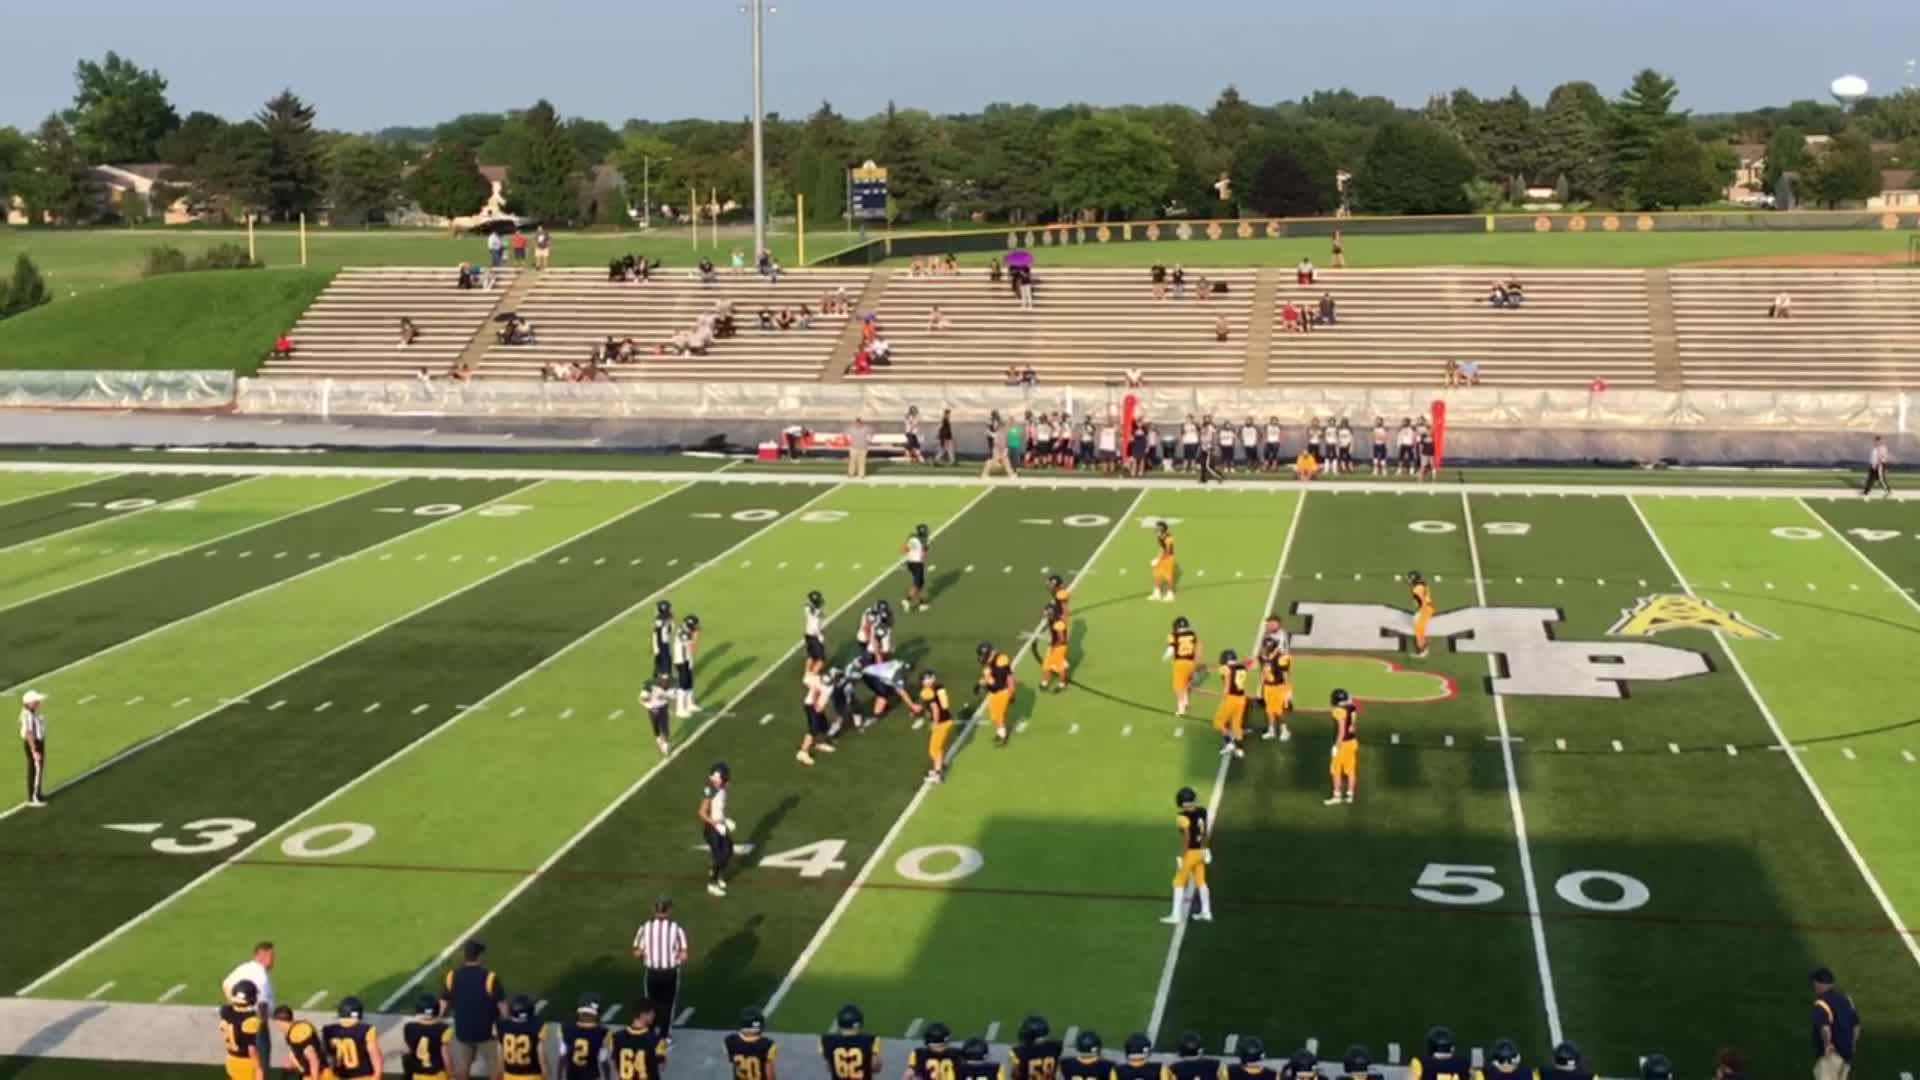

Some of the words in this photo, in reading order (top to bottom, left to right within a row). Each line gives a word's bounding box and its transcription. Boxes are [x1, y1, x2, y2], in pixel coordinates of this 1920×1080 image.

[416, 1036, 431, 1067] 4
[502, 1033, 531, 1065] 82
[572, 1038, 589, 1065] 2
[619, 1048, 648, 1080] 64
[833, 1047, 864, 1079] 62
